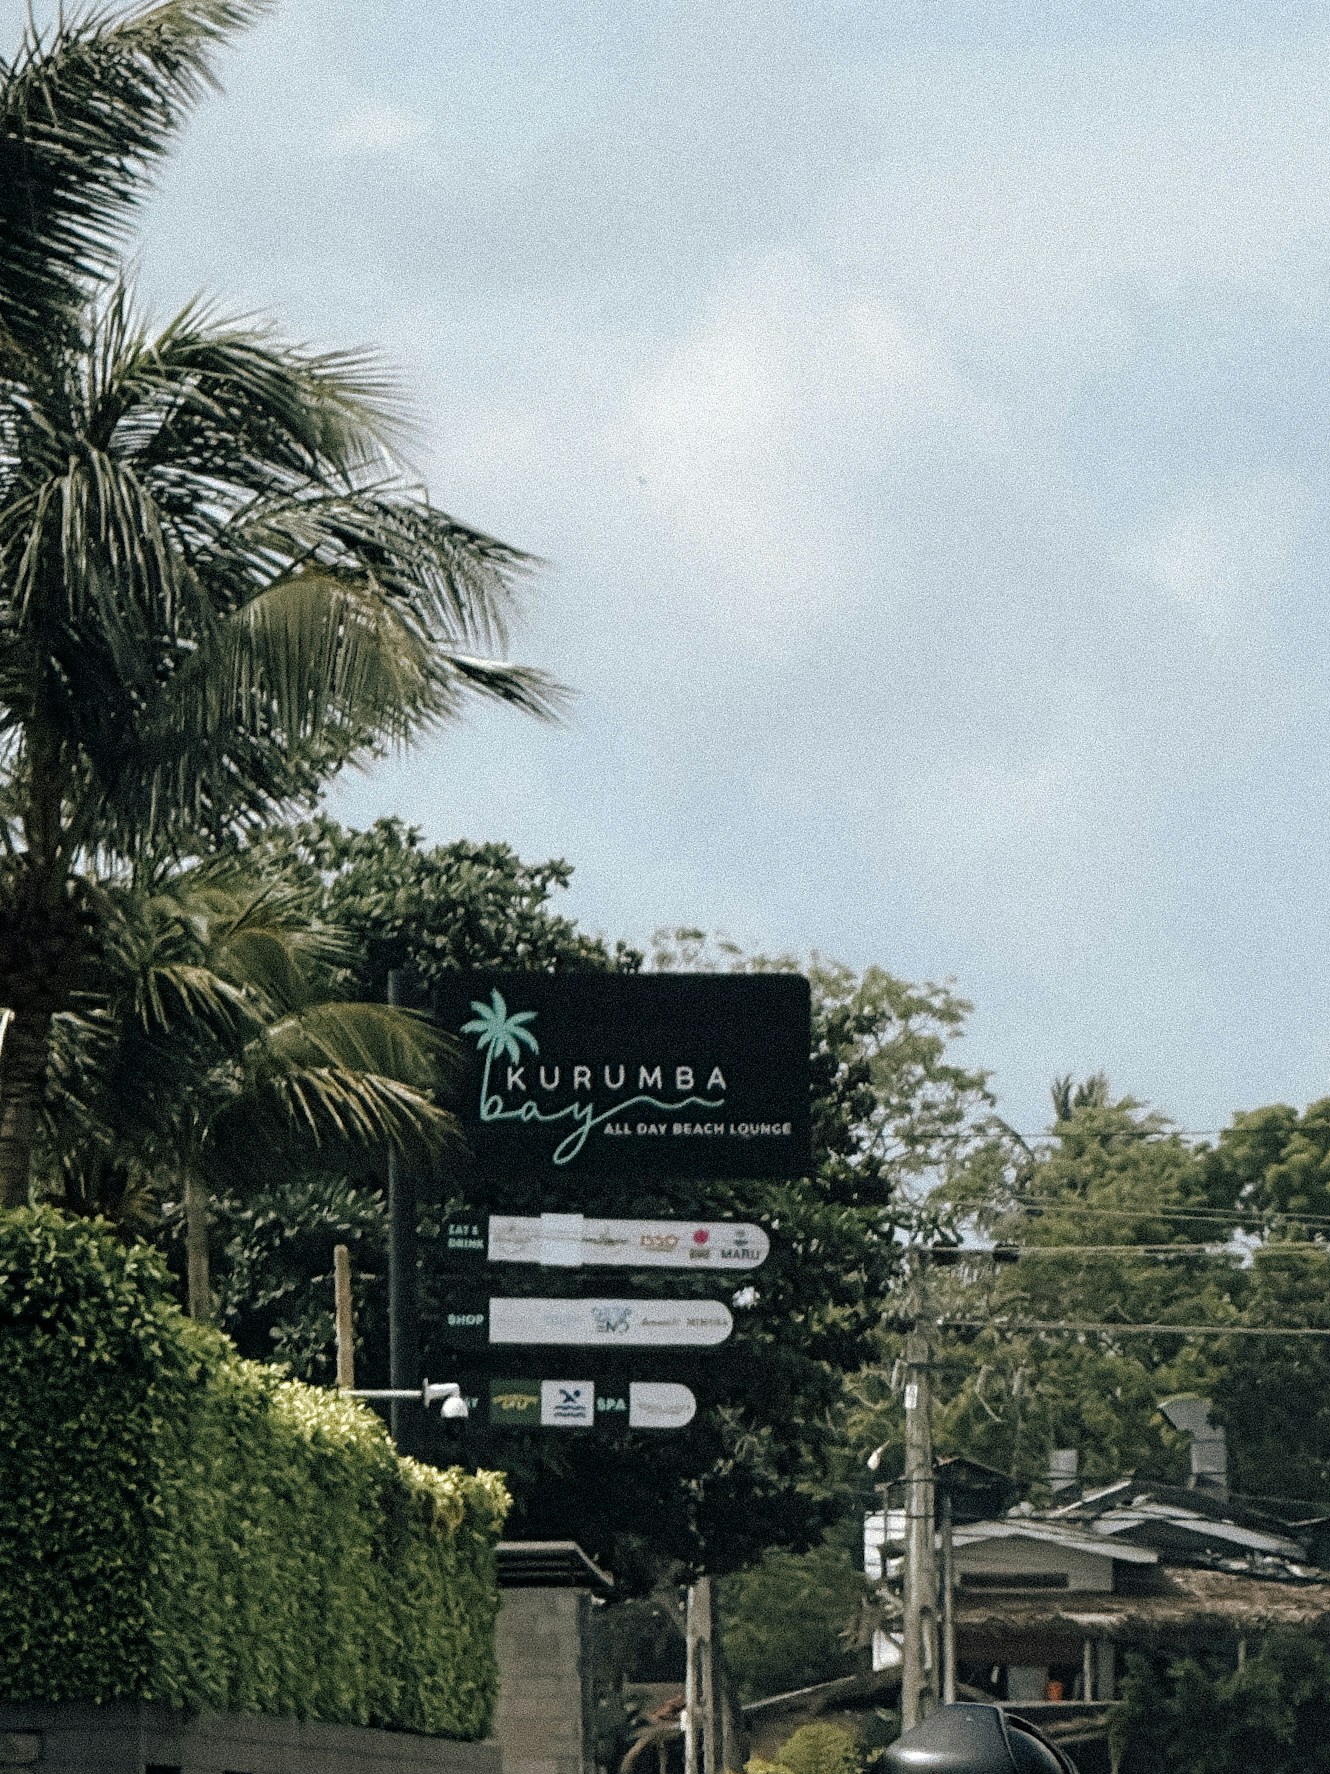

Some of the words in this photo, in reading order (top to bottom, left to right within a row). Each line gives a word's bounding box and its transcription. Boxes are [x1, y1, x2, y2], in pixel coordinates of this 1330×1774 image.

[507, 1064, 728, 1091] KURUMBA
[603, 1122, 633, 1136] ALL
[636, 1122, 668, 1136] DAY
[671, 1122, 726, 1136] BEACH
[729, 1121, 793, 1137] LOUNGE
[447, 1313, 485, 1327] SHOP
[597, 1397, 628, 1412] SPA
